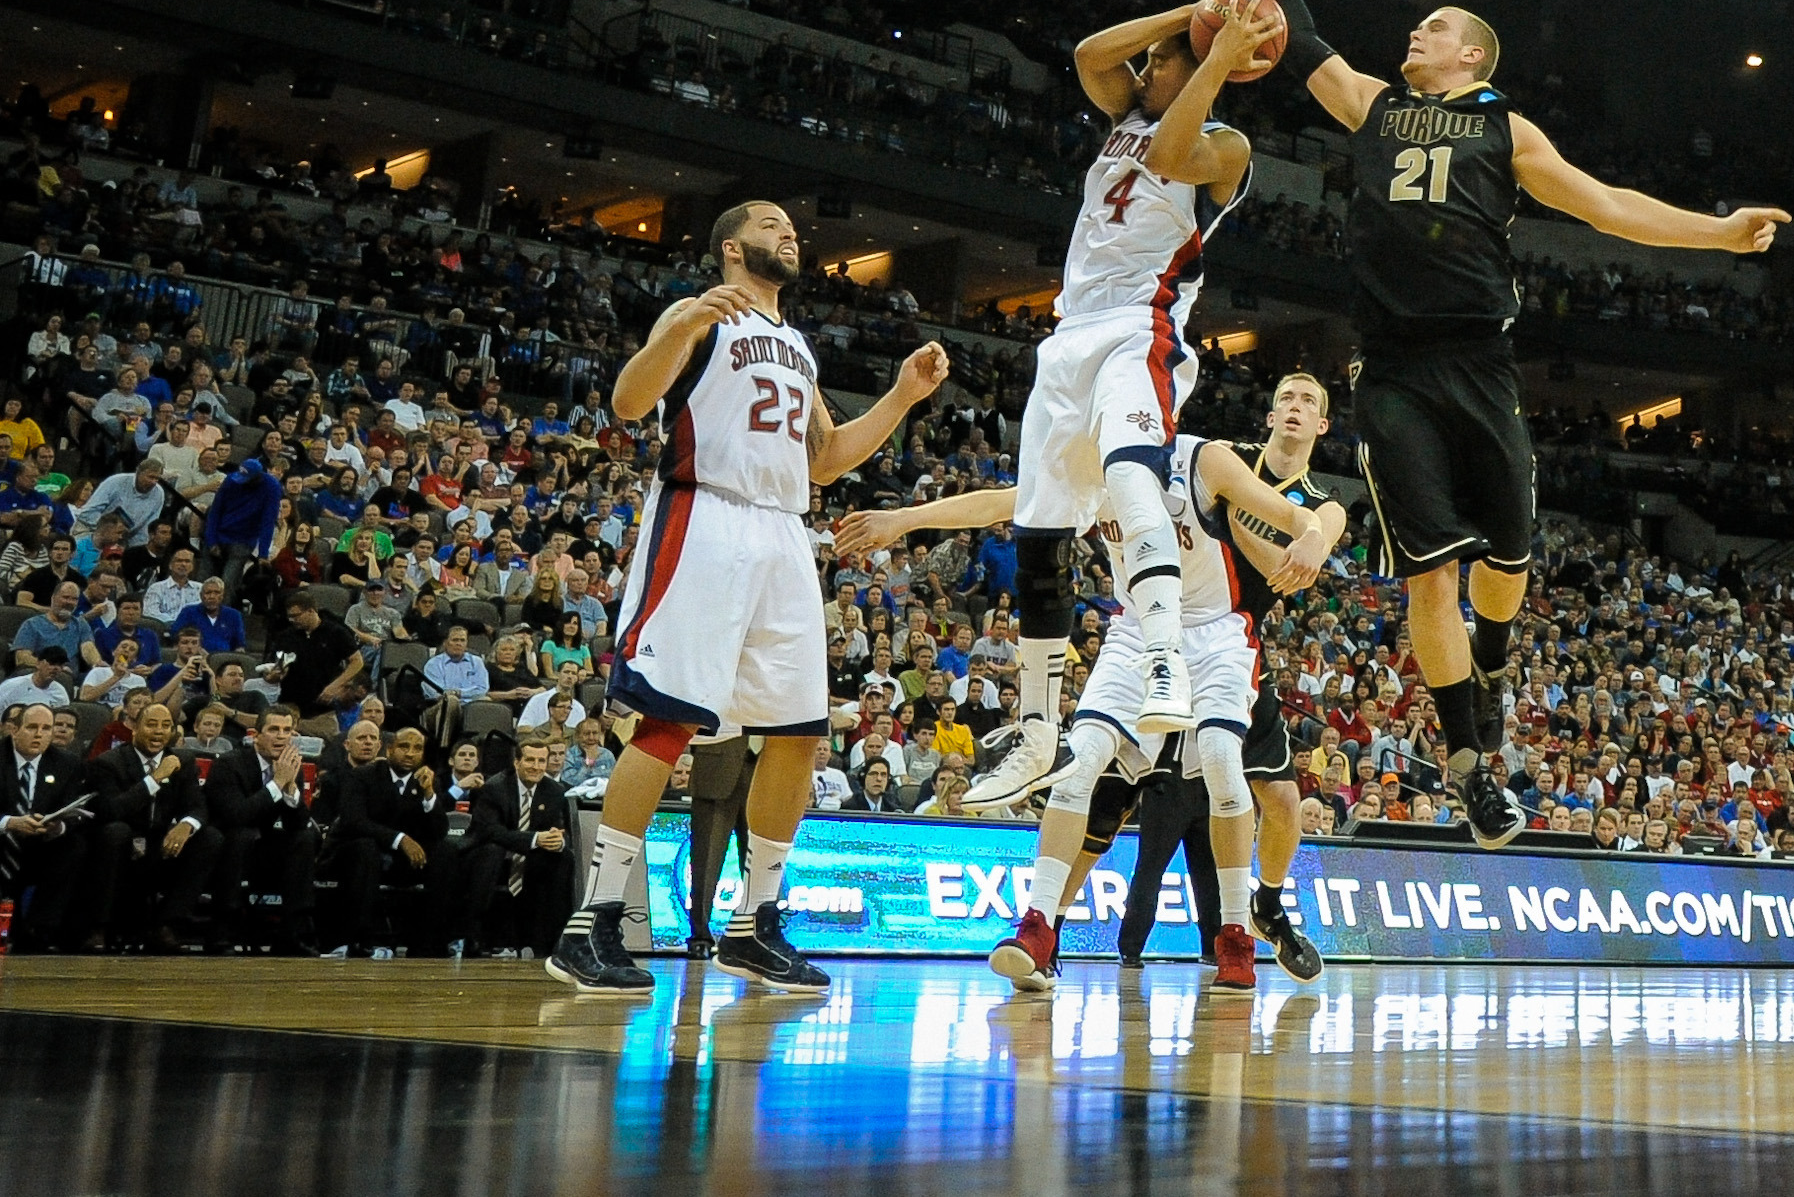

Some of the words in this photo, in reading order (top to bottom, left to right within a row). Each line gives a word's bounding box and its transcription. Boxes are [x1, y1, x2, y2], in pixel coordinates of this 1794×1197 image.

[1380, 106, 1485, 145] PURDUE
[1103, 168, 1142, 225] 4
[1389, 146, 1453, 203] 21
[748, 375, 804, 444] 22
[1314, 878, 1360, 927] IT
[1376, 880, 1501, 930] LIVE.
